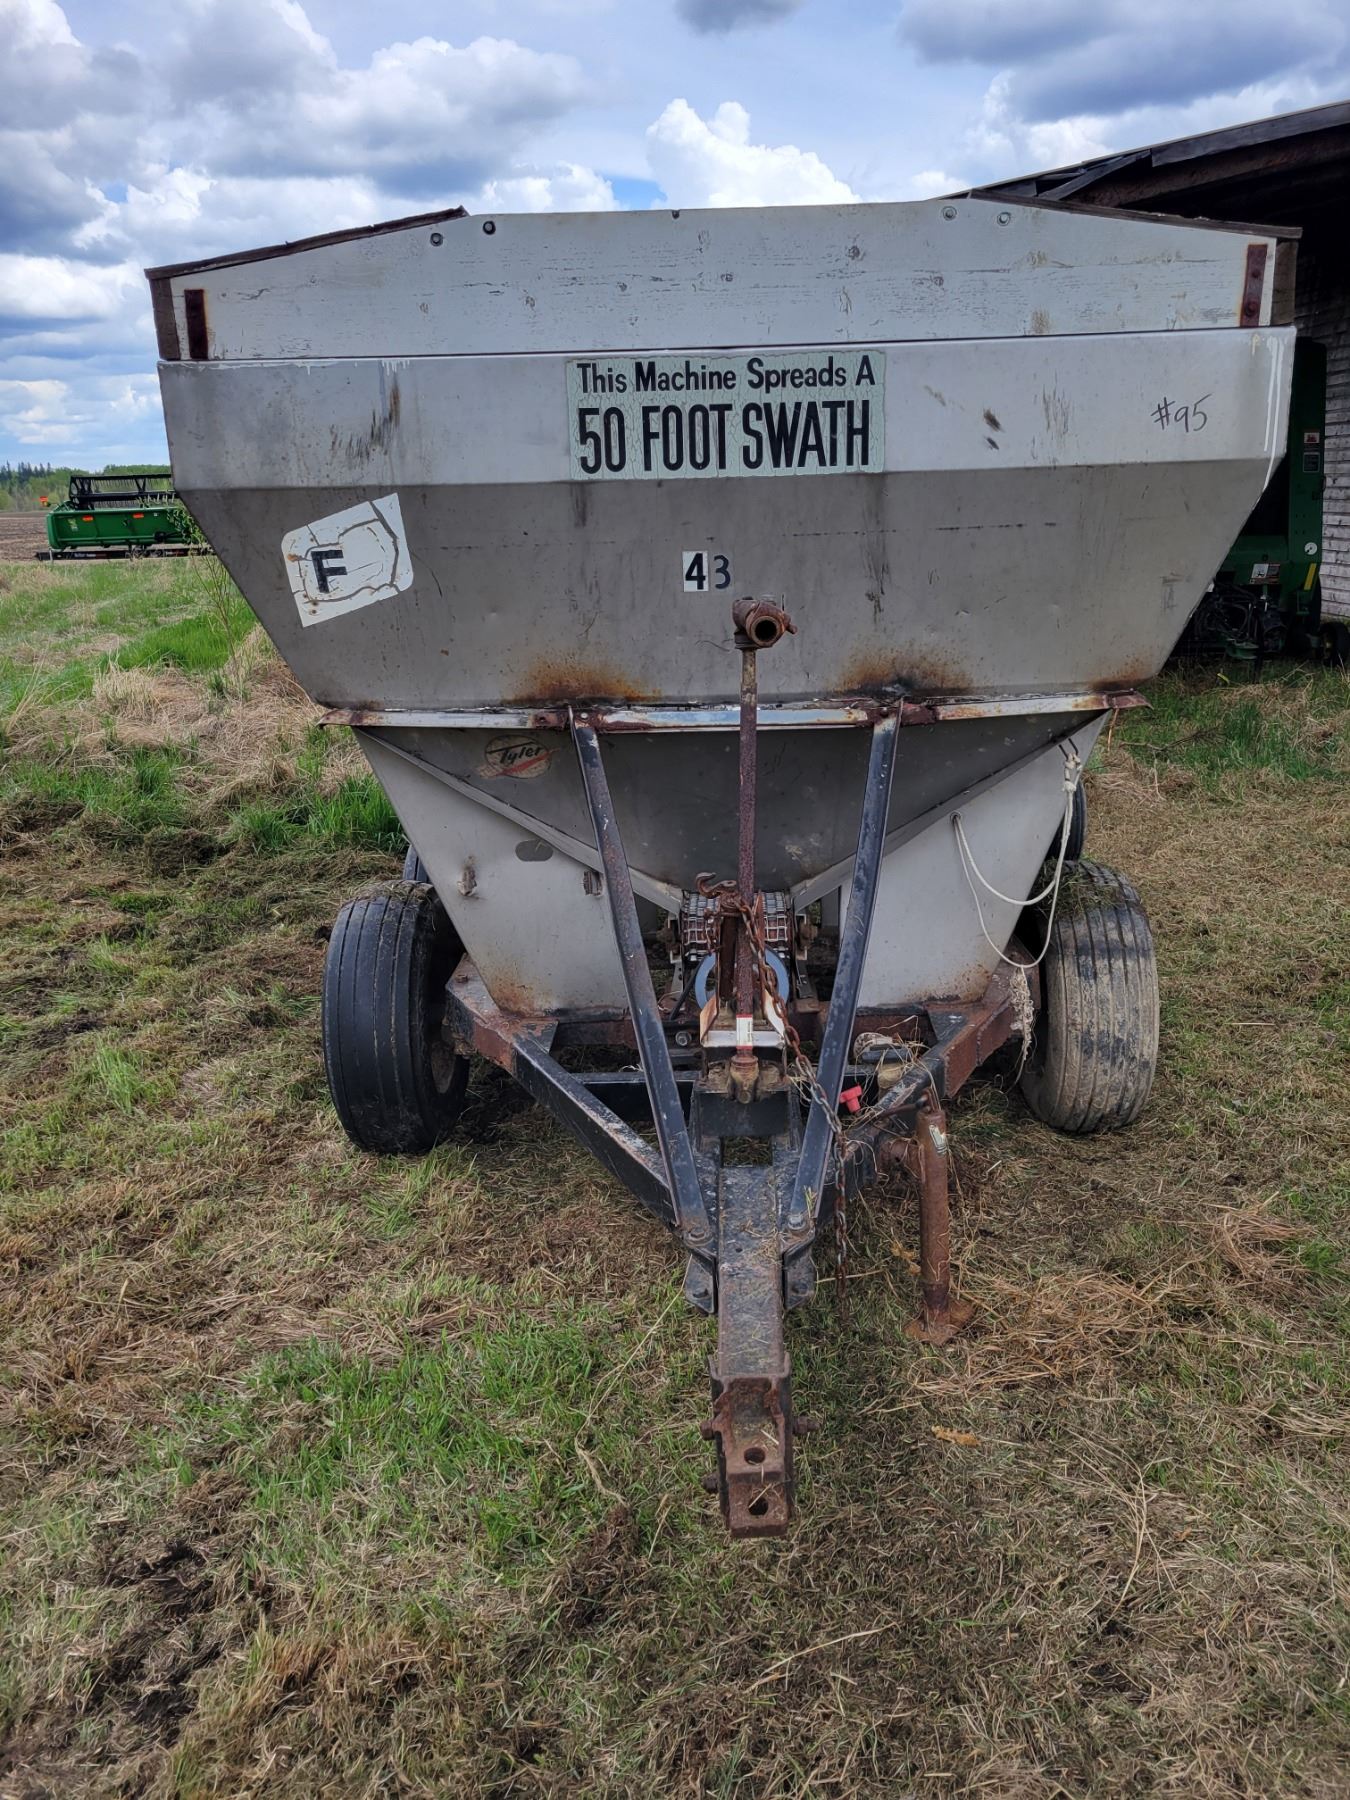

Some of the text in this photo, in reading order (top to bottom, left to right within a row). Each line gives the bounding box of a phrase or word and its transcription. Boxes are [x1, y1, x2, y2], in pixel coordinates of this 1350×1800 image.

[576, 355, 876, 394] This Machine Spreads A
[1150, 393, 1213, 433] #95
[578, 400, 870, 474] 50 FOOT SWATH
[311, 549, 348, 593] F
[685, 552, 731, 589] 43
[485, 741, 543, 769] Tyler
